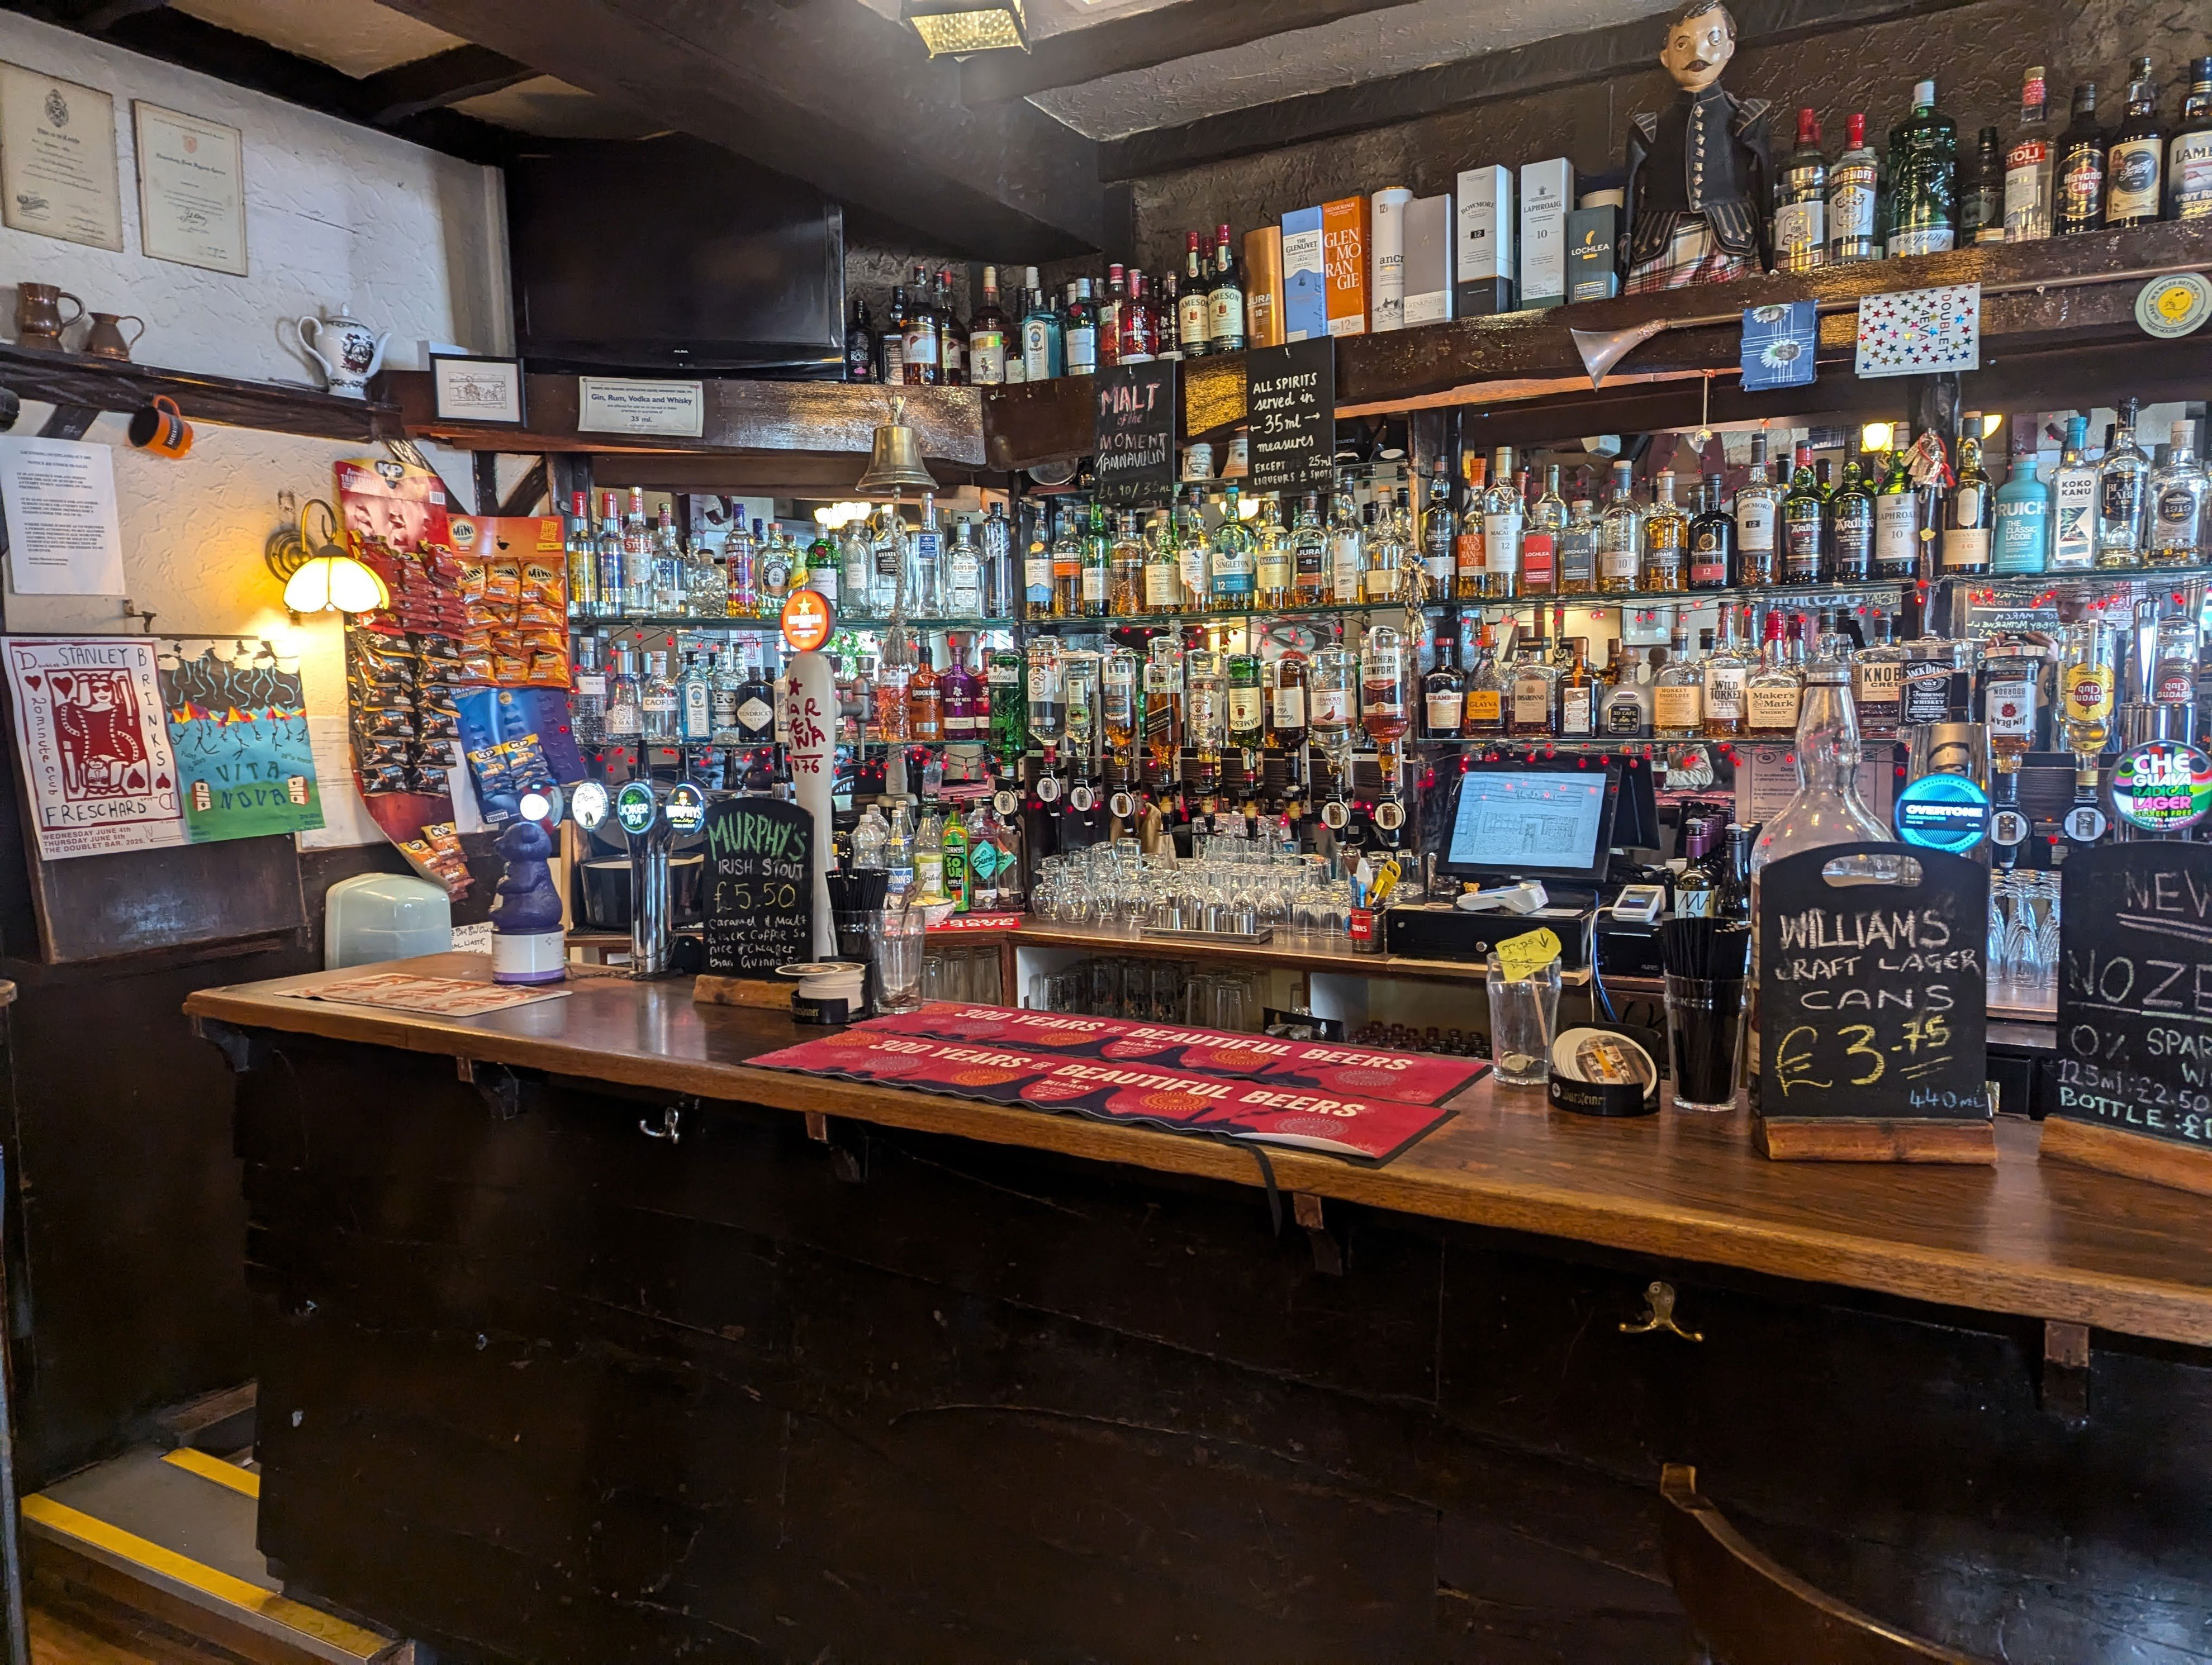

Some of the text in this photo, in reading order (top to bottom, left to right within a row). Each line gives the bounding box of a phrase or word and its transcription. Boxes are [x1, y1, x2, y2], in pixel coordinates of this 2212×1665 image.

[2006, 146, 2039, 164] STOLI
[2064, 171, 2102, 185] Havana
[2071, 180, 2096, 195] Club
[1460, 201, 1495, 215] BOWMORE
[1324, 227, 1360, 248] GLEN
[1536, 230, 1548, 239] 10
[1285, 241, 1318, 253] GLENLIVET
[1337, 243, 1362, 261] MO
[1571, 244, 1610, 256] LOCHLEA
[1326, 259, 1354, 278] RAN
[1337, 272, 1360, 290] GIE
[1247, 293, 1271, 306] JURA
[1255, 309, 1262, 317] 10
[1341, 319, 1351, 330] 12
[1918, 310, 1930, 342] 4EVA
[1939, 294, 1952, 354] DOUBLET
[1253, 372, 1318, 394] ALL SPIRITS
[667, 397, 692, 406] Whisky
[1100, 383, 1161, 416] MALT
[1254, 389, 1315, 412] served in
[1099, 432, 1167, 450] MOMENT
[1257, 435, 1314, 453] measures
[377, 462, 404, 475] KP
[1255, 460, 1285, 473] EXCEPT
[1254, 469, 1333, 486] LIQUEURS & SHOTS
[2062, 487, 2092, 496] KANU
[2106, 483, 2144, 492] BLACK
[1738, 503, 1772, 512] BOWMORE
[2164, 505, 2192, 514] 1919
[1791, 522, 1822, 532] Ardbeg
[1834, 518, 1874, 532] Ardbeg
[1461, 536, 1480, 544] GLEN
[1891, 530, 1903, 539] 10
[625, 540, 651, 550] STOLI
[726, 544, 754, 553] SMIRNOFF
[763, 562, 786, 579] PLYMOUTH
[1215, 560, 1249, 569] SINGLETON
[1618, 559, 1627, 569] 10
[58, 647, 128, 667] STANLEY
[1363, 655, 1397, 665] SOUTHERN
[1364, 665, 1395, 675] COMFORT
[1864, 667, 1900, 682] KNOB
[1906, 664, 1925, 679] JACK
[879, 673, 907, 684] Gordon's
[1715, 680, 1738, 690] WILD
[2078, 684, 2100, 694] Club
[2164, 682, 2187, 692] Club
[1710, 688, 1741, 700] TURKEY
[2071, 694, 2107, 703] Havana
[2156, 691, 2193, 700] Havana
[1990, 715, 2028, 729] JIM BEAM
[510, 740, 528, 748] KP
[476, 749, 494, 758] KP
[2133, 753, 2191, 774] CHE
[216, 760, 279, 782] VITA
[2132, 773, 2191, 787] GUAVA
[2132, 786, 2193, 798] RADICAL
[220, 788, 287, 810] NOVA
[2133, 796, 2192, 810] LAGER
[45, 800, 146, 827] FRESCHARD
[619, 803, 649, 816] JOKER
[666, 805, 702, 820] MURPHY'S
[1905, 805, 1983, 817] OVERTONE
[626, 814, 642, 825] IPA
[42, 830, 93, 840] WEDNESDAY
[96, 827, 117, 836] JUNE
[707, 811, 808, 862] MURPHY'S
[43, 838, 88, 848] THURSDAY
[64, 843, 102, 853] DOUBLET
[105, 840, 124, 849] BAR.
[943, 845, 965, 854] CORKY'S
[718, 858, 804, 879] IRISH STOUT
[946, 857, 961, 867] SO
[714, 881, 796, 913] £5.50
[1779, 907, 1950, 950] WILLIAMS
[1502, 939, 1534, 956] Tips
[1775, 949, 1981, 981] CRAFT LAGER
[1801, 985, 1955, 1011] CANS
[953, 1008, 1011, 1022] 300
[1010, 1012, 1106, 1033] YEARS
[1126, 1027, 1292, 1057] BEAUTIFUL
[1298, 1047, 1413, 1072] BEERS
[868, 1039, 936, 1055] 300
[929, 1045, 1033, 1068] YEARS
[1051, 1063, 1233, 1100] BEAUTIFUL
[1238, 1090, 1367, 1118] BEERS
[2060, 1086, 2166, 1128] BOTTLE
